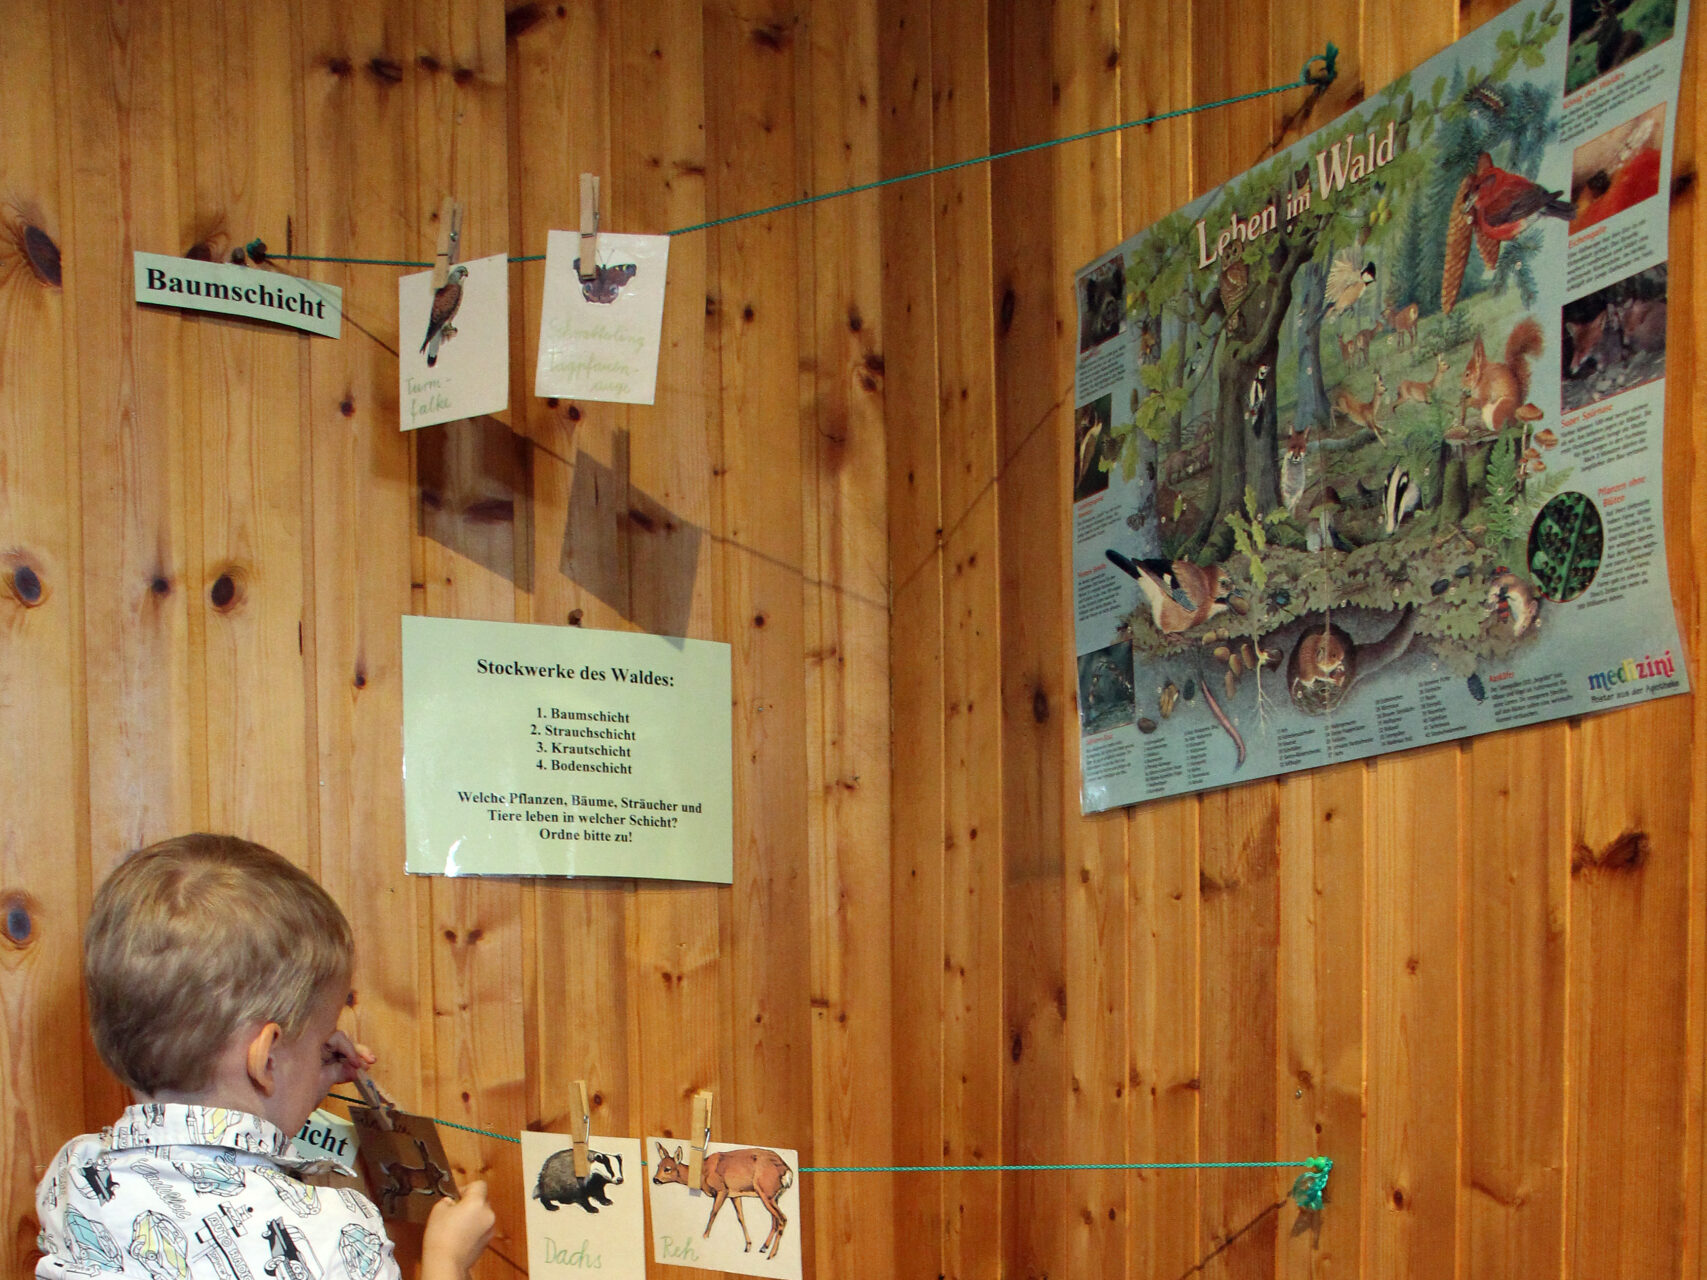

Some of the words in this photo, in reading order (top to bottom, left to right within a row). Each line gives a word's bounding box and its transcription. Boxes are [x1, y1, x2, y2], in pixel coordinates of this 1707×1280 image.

[1196, 203, 1278, 270] Leben
[1286, 190, 1311, 222] im
[1315, 119, 1396, 201] Wald
[145, 267, 326, 320] Baumschicht
[477, 658, 575, 679] Stockwerke
[580, 665, 606, 682] des
[611, 667, 675, 687] Waldes:
[1587, 649, 1675, 692] medizini
[536, 706, 547, 719] 1.
[551, 707, 631, 724] Baumschicht
[530, 723, 541, 736] 2.
[545, 724, 637, 741] Strauchschicht
[536, 741, 547, 753] 3.
[551, 741, 632, 758] Krautschicht
[536, 759, 547, 770] 4.
[551, 759, 633, 775] Bodenschicht
[457, 790, 505, 804] Welche
[509, 791, 568, 807] Pflanzen,
[571, 794, 618, 809] Bäume,
[621, 796, 678, 812] Sträucher
[681, 802, 703, 814] und
[487, 808, 522, 822] Tiere
[525, 809, 559, 823] leben
[562, 810, 575, 823] in
[579, 812, 626, 826] welcher
[629, 813, 678, 828] Schicht?
[539, 827, 580, 840] Ordne
[583, 828, 611, 842] bitte
[614, 829, 633, 843] zu!
[295, 1119, 349, 1157] icht
[208, 1217, 232, 1247] AUTO
[543, 1236, 603, 1269] Dachs
[659, 1235, 700, 1262] Reh
